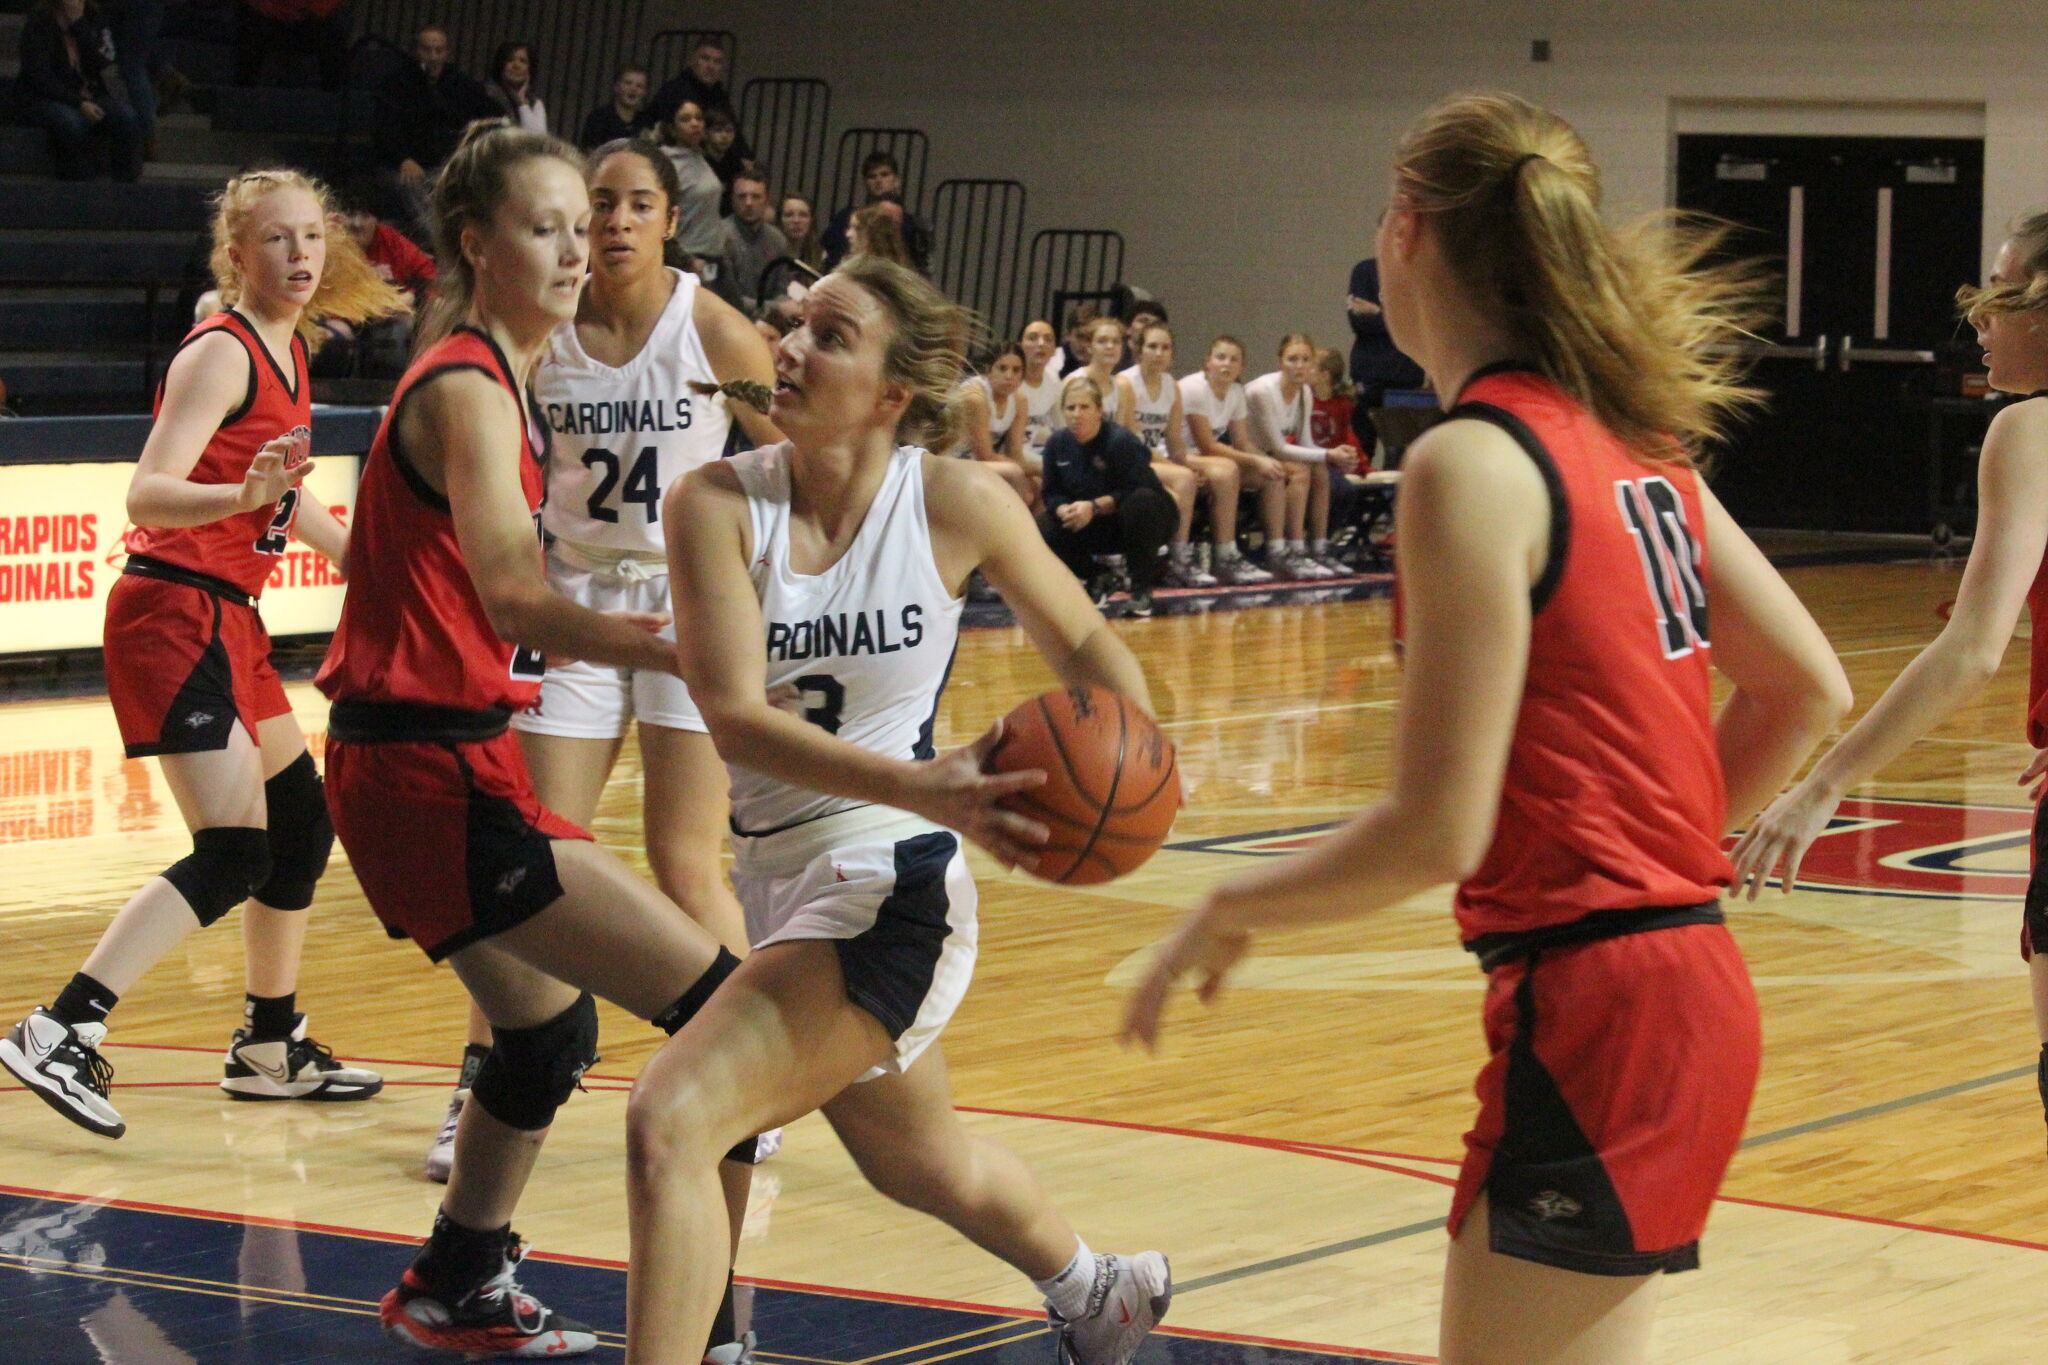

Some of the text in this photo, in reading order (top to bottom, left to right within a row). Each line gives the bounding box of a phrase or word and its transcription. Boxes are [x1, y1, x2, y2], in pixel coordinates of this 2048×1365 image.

[548, 398, 692, 434] CARDINALS
[581, 446, 660, 524] 24
[0, 513, 97, 555] RAPIDS
[253, 486, 302, 556] 2
[0, 560, 95, 603] DINALS
[268, 551, 346, 589] STER
[767, 603, 923, 662] RDINALS
